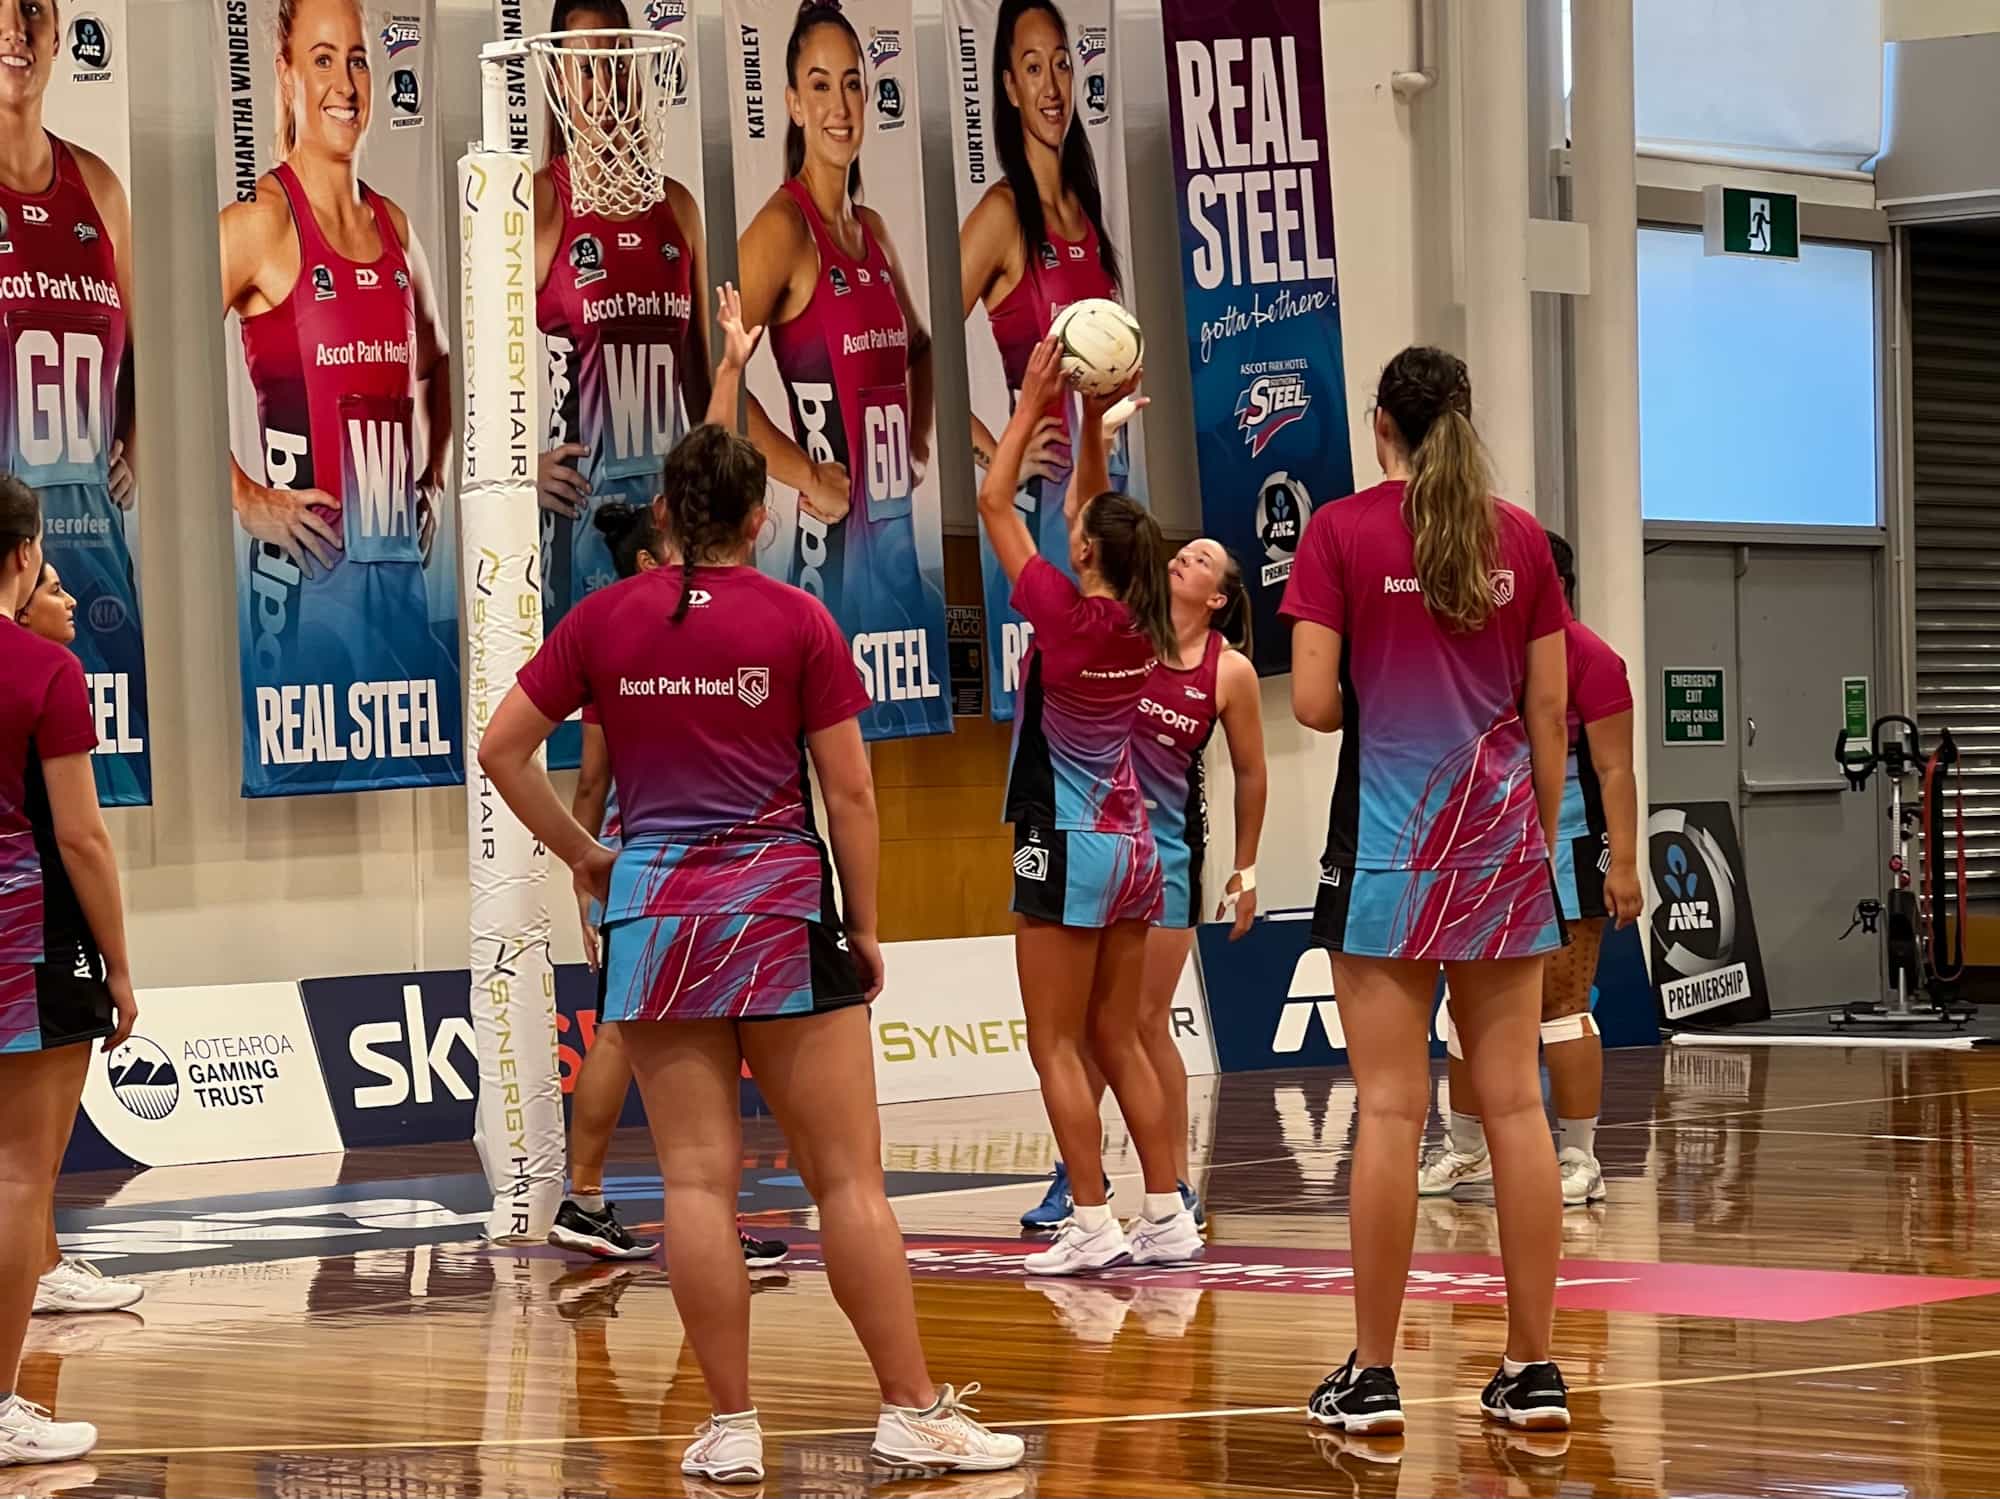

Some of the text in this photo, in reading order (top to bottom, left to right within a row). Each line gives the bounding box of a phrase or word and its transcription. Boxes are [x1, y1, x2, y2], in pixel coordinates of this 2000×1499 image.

[386, 23, 420, 46] STEEL
[1081, 35, 1105, 55] STEE
[740, 24, 766, 139] KATE BURLEY
[227, 0, 257, 203] SAMANTHA WINDERS
[958, 26, 986, 184] COURTNEY ELLIOTT
[1175, 36, 1319, 170] REAL
[510, 113, 529, 153] NEE
[1187, 167, 1336, 290] STEEL
[0, 271, 121, 309] cot Park Hotel
[583, 293, 625, 324] Ascot
[626, 290, 661, 315] Park
[1201, 272, 1338, 363] gotta be there!
[316, 342, 354, 367] Ascot
[357, 340, 383, 363] Park
[843, 332, 870, 356] Ascot
[869, 328, 888, 349] Park
[1240, 361, 1267, 375] ASCOT
[1284, 357, 1309, 370] HOTEL
[16, 330, 104, 466] GD
[603, 343, 675, 460] WD
[1246, 379, 1308, 425] STEEL
[864, 404, 911, 501] GD
[348, 419, 411, 537] WA
[1269, 520, 1296, 539] ANZ
[852, 629, 941, 702] STEEL
[619, 675, 734, 696] Ascot Park Hotel
[1686, 689, 1702, 703] EXIT
[256, 679, 451, 765] REAL STEEL
[1137, 697, 1200, 735] SPORT
[1668, 901, 1714, 931] ANZ
[1667, 970, 1744, 1013] PREMIERSHIP
[184, 1034, 295, 1060] AOTEAROA
[188, 1059, 280, 1084] GAMING
[194, 1085, 265, 1108] TRUST
